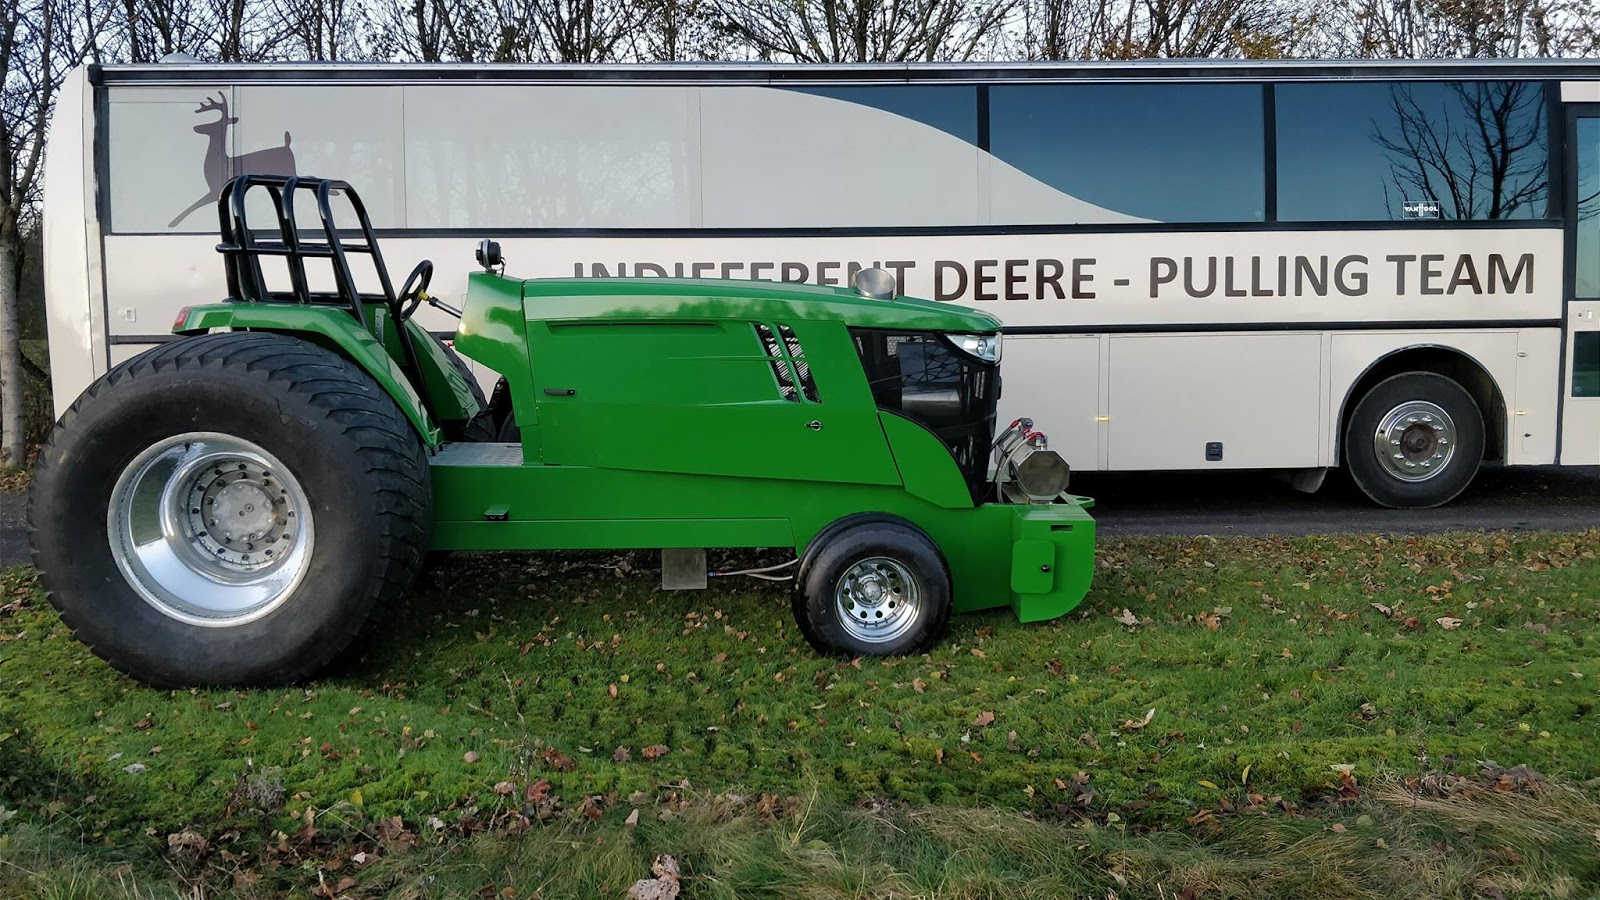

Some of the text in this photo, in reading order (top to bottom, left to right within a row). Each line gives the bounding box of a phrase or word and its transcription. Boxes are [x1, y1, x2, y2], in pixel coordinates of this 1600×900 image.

[934, 259, 1097, 301] DEERE
[1149, 254, 1369, 298] PULLING
[1385, 253, 1535, 296] TEAM
